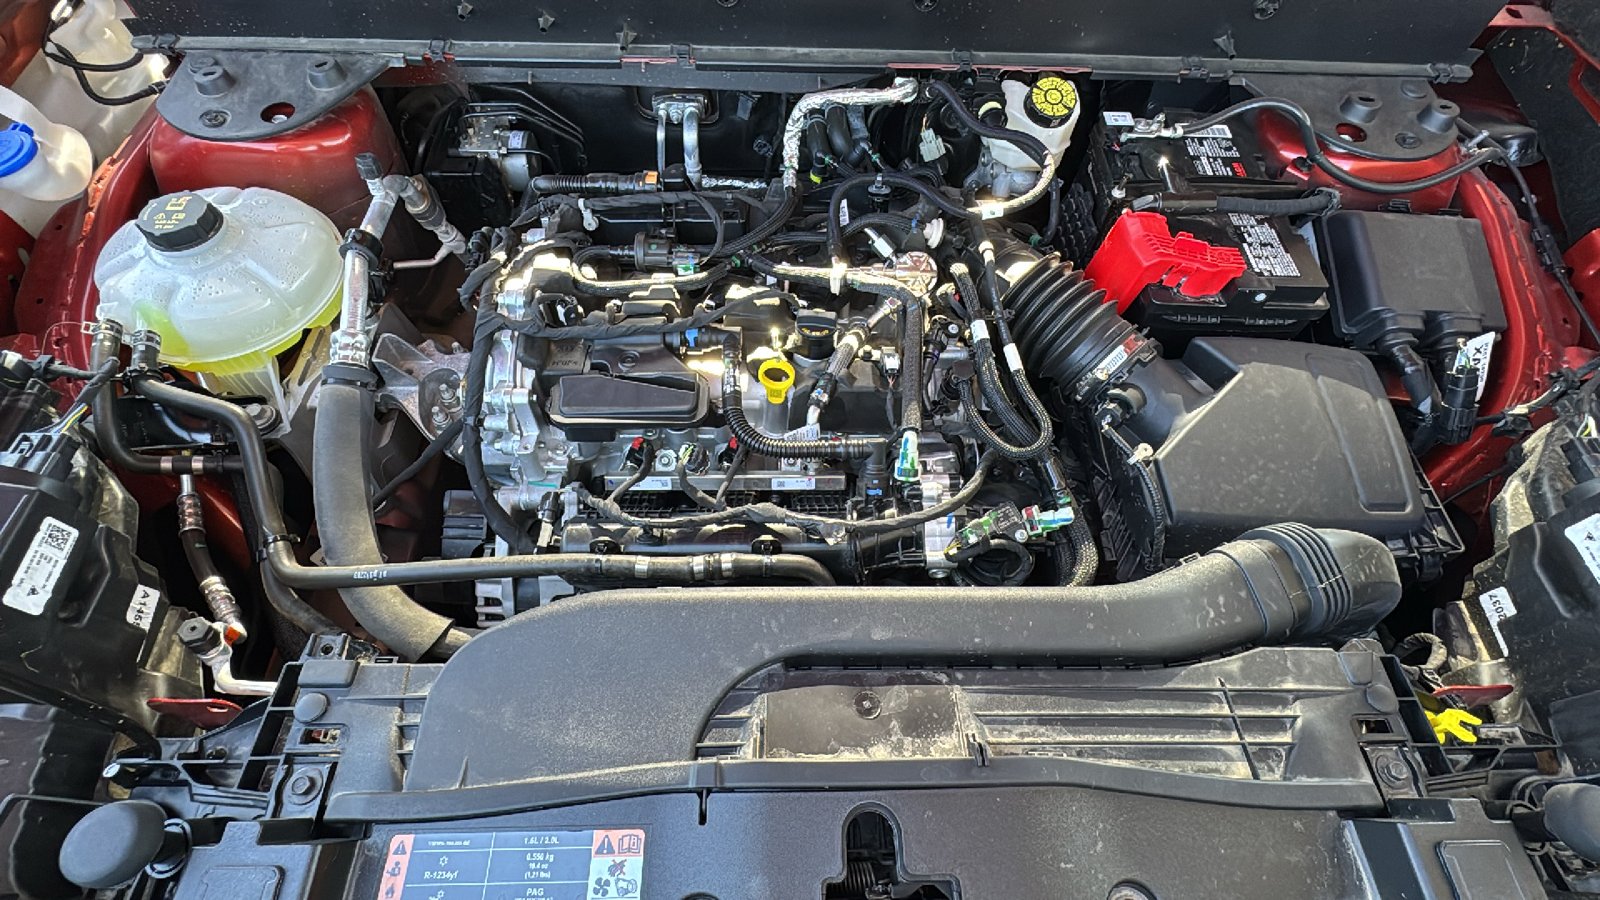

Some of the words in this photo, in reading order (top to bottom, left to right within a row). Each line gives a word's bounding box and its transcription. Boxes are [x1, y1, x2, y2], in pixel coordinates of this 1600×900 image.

[1488, 594, 1506, 620] 2037
[544, 836, 560, 844] 2.0L
[545, 852, 554, 863] kg
[423, 870, 459, 880] R-1234yf
[526, 887, 544, 896] PAG
